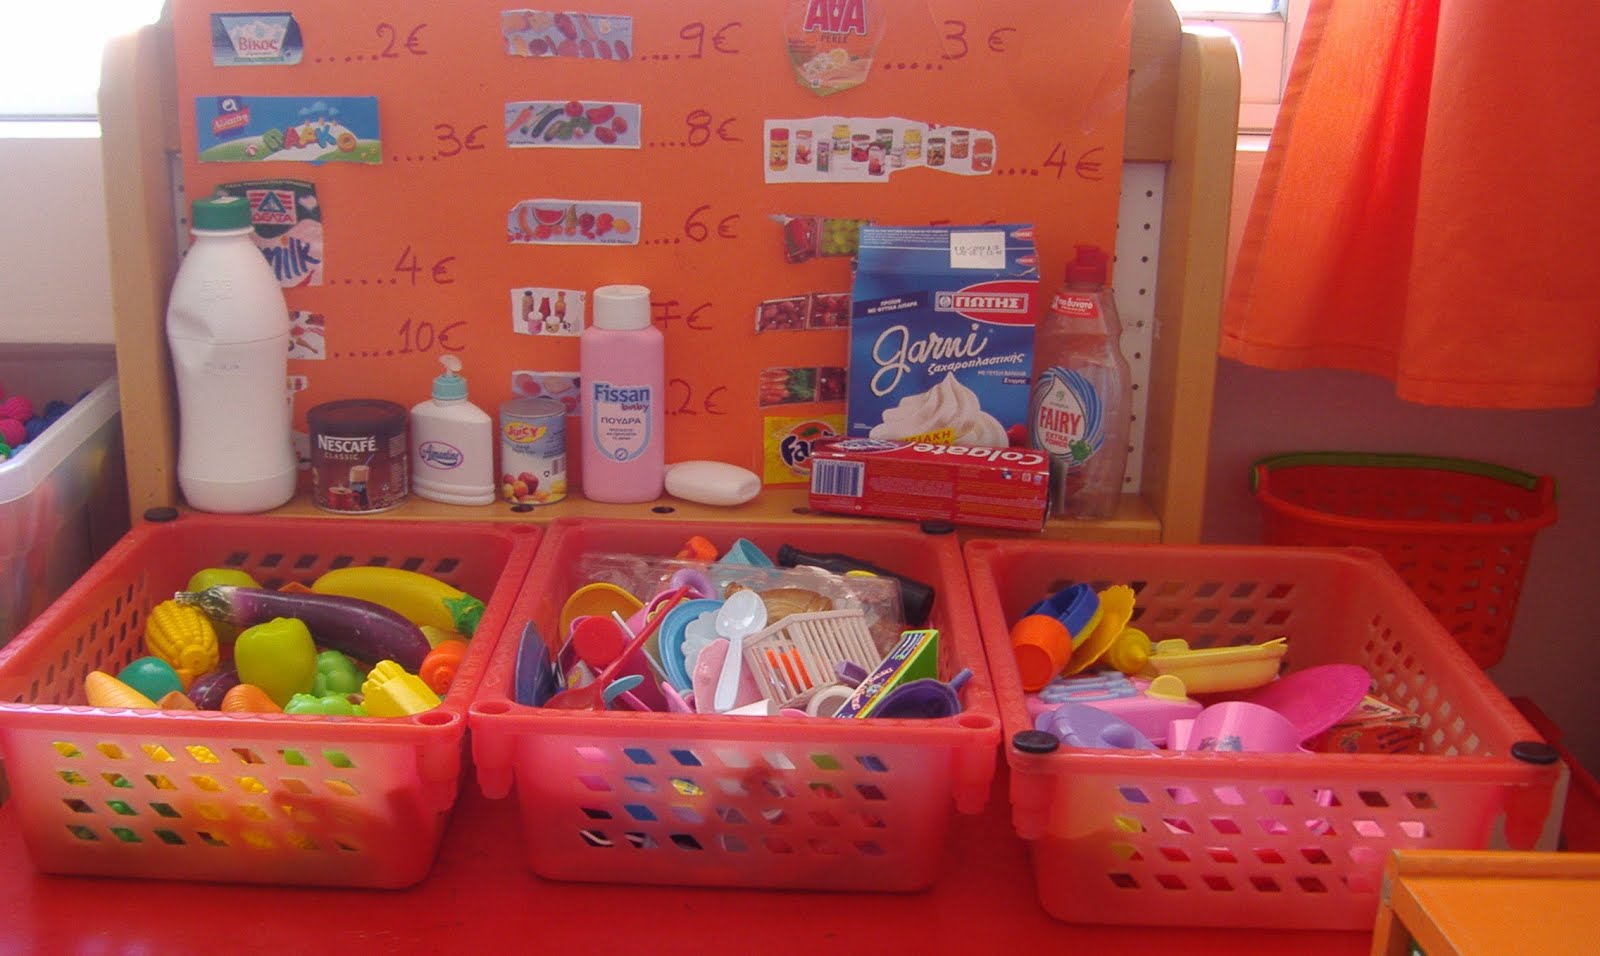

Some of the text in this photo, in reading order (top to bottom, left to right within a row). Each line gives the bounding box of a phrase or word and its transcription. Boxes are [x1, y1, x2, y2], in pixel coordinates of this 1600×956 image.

[955, 296, 1020, 309] ΓΙΩΤΗΣ
[594, 384, 650, 402] Fissan
[621, 402, 650, 413] baby
[1040, 406, 1081, 436] FAIRY
[318, 434, 376, 453] NESCAFÉ
[324, 452, 360, 460] CLASSIC
[913, 442, 1044, 465] Colgate
